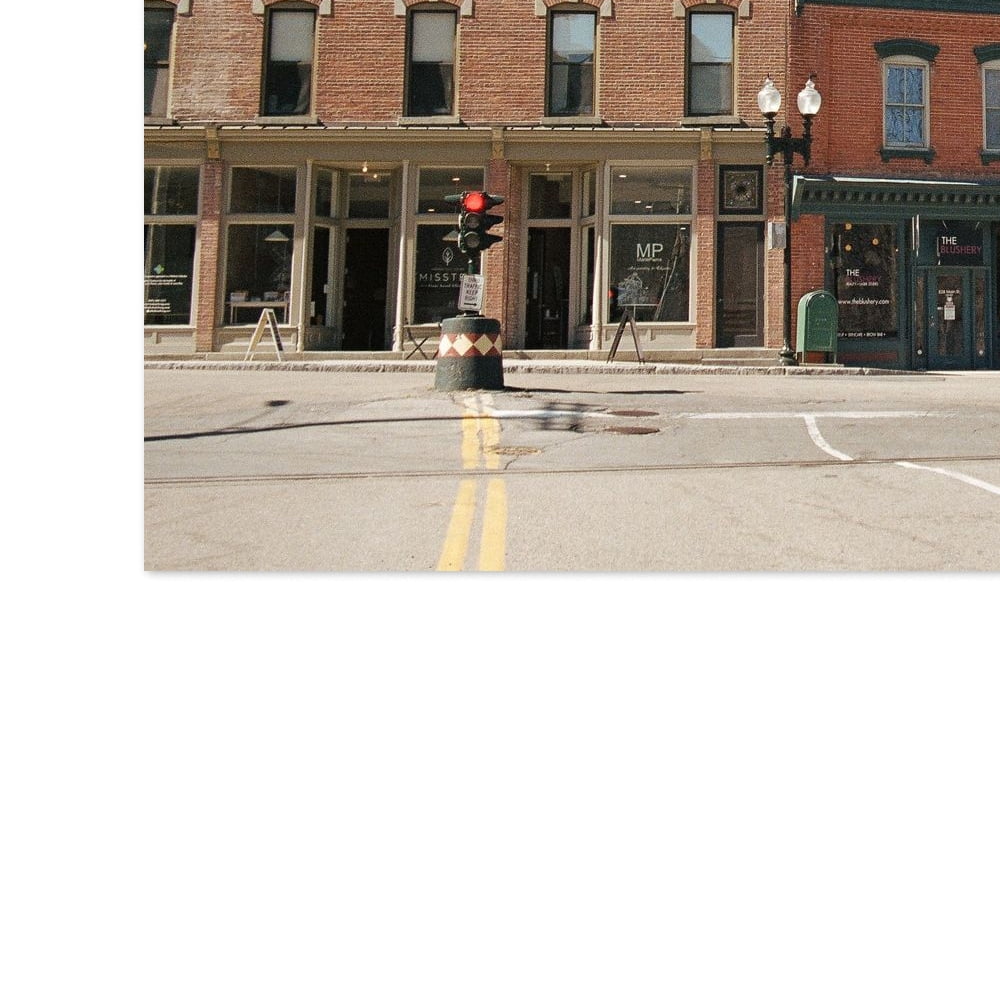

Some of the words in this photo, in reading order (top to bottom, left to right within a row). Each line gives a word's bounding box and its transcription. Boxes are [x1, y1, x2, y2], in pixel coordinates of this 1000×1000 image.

[941, 235, 957, 245] THE
[636, 243, 664, 258] MP
[940, 245, 982, 255] BLUSHERY
[846, 268, 860, 277] THE
